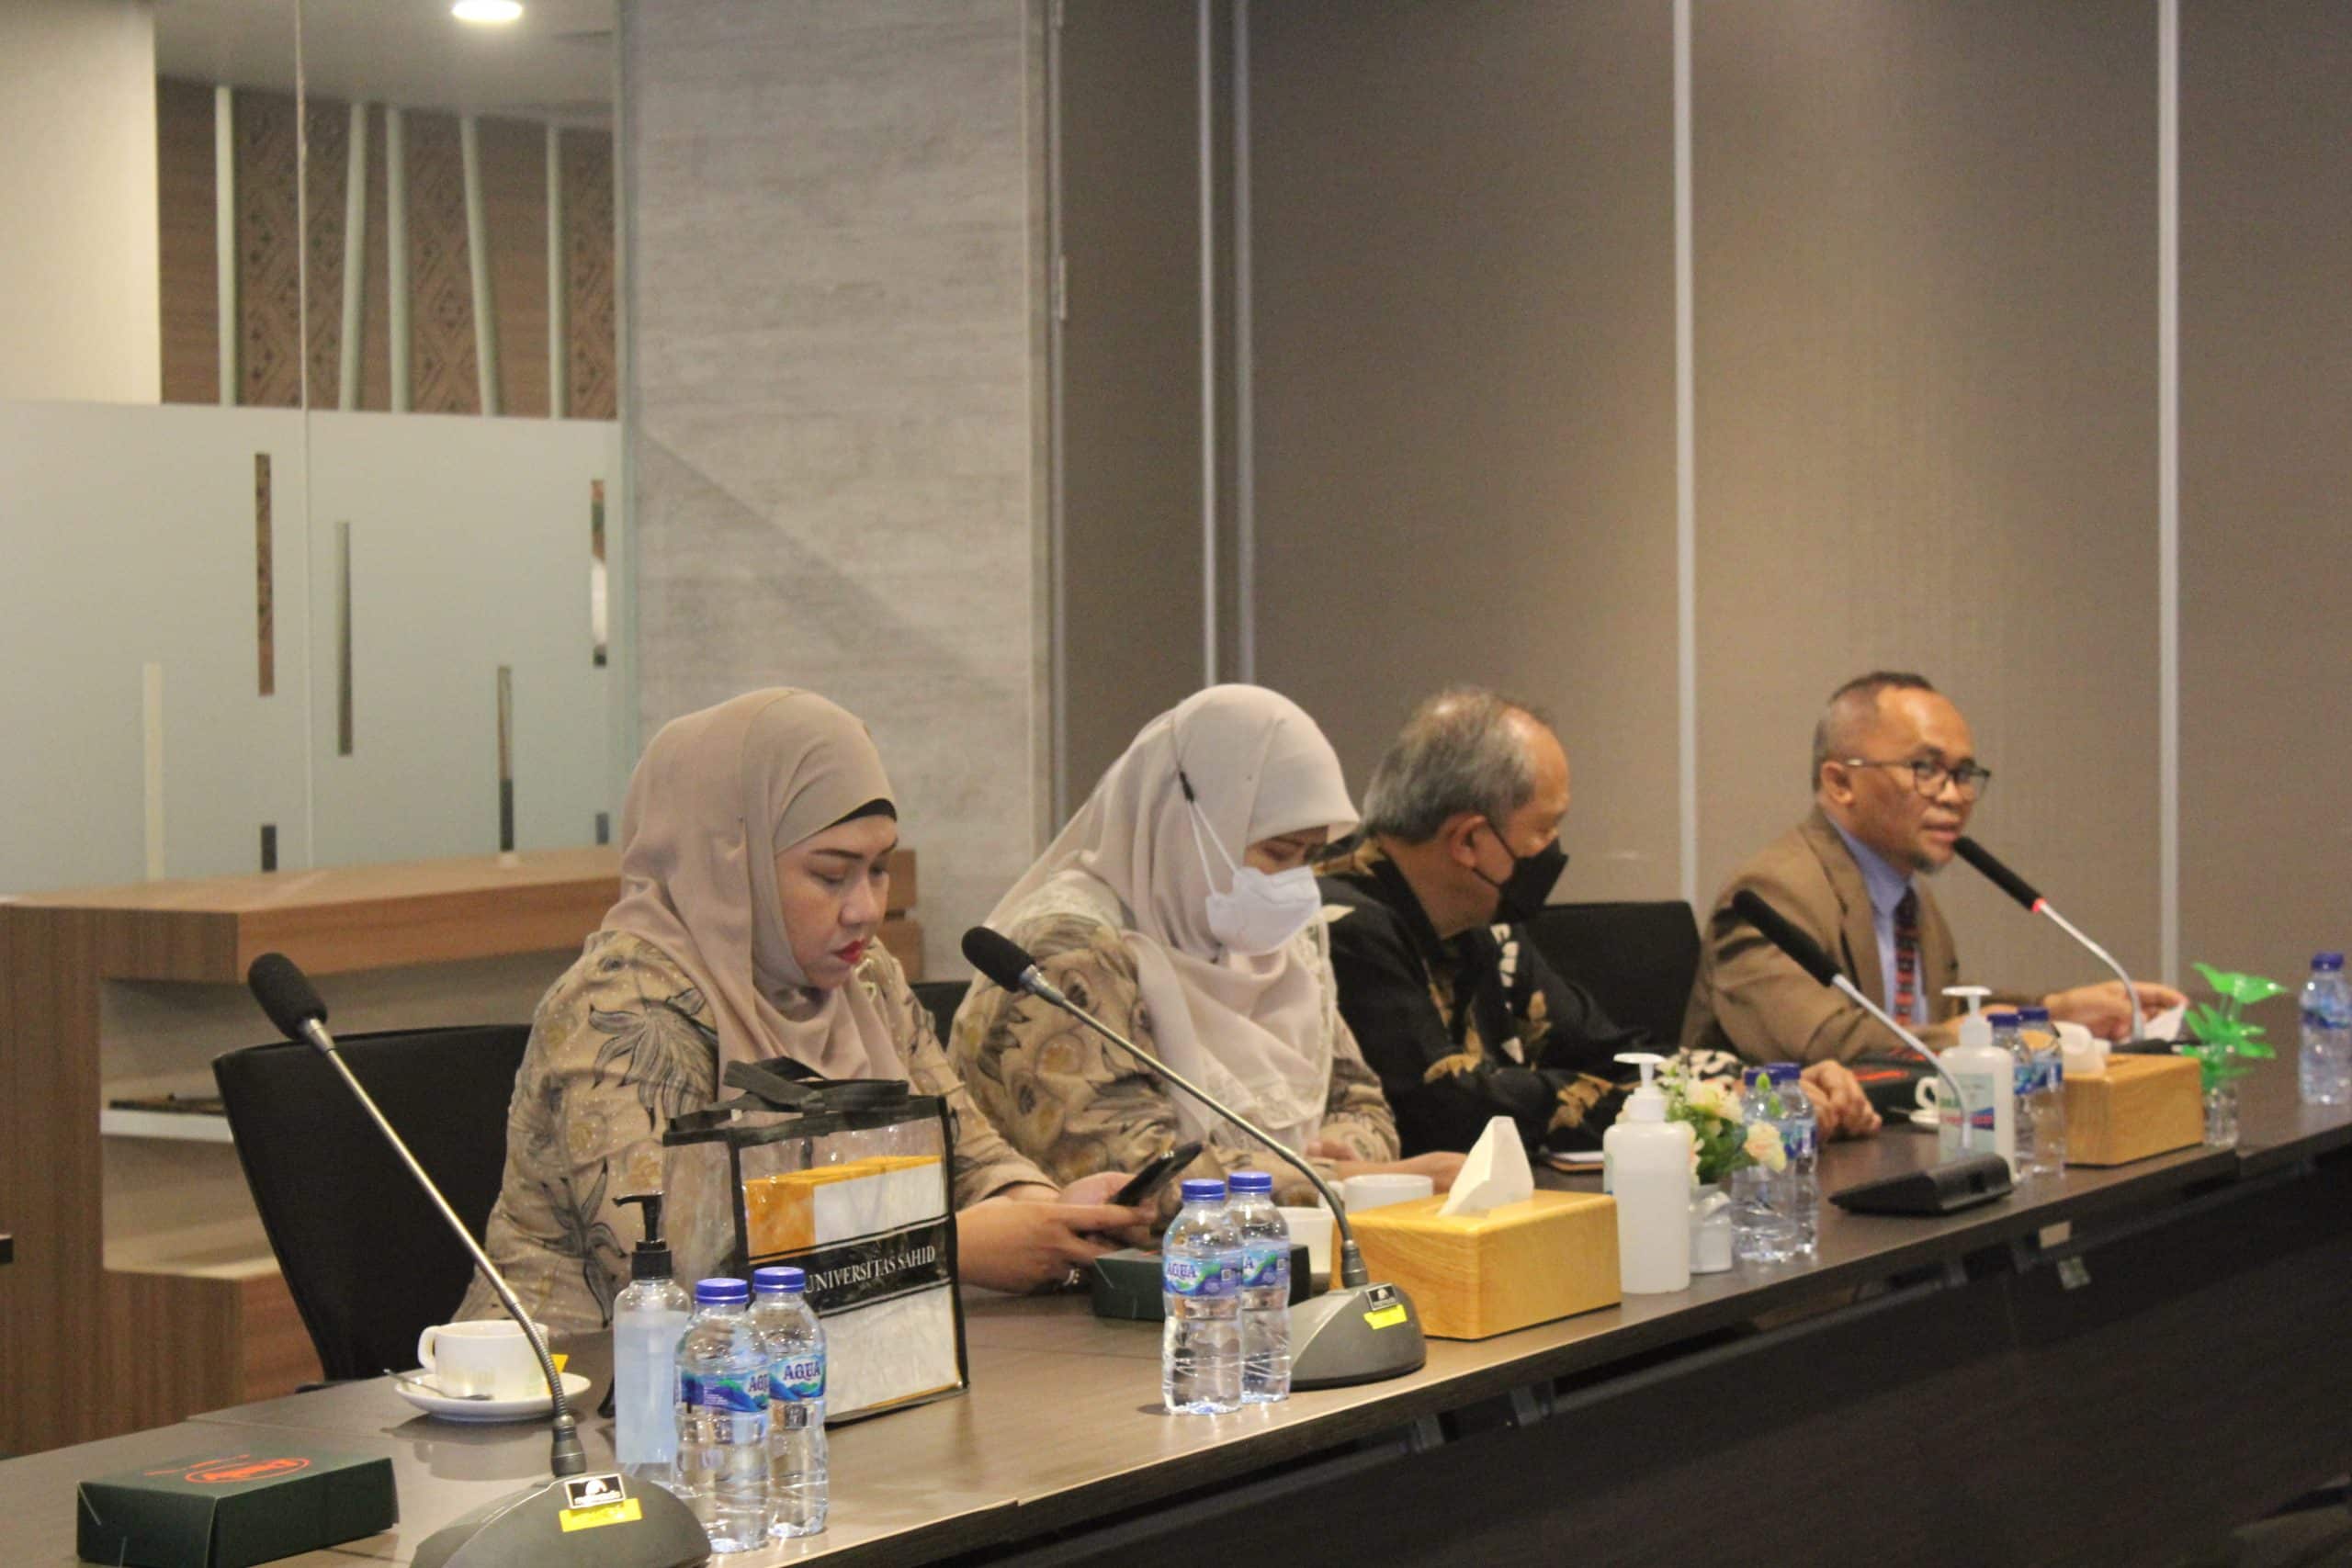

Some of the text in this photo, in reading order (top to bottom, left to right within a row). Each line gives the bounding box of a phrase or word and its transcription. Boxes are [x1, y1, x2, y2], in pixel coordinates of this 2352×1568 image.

[805, 1246, 935, 1293] UNIVERSITAS SAHID
[783, 1361, 821, 1381] AQUA
